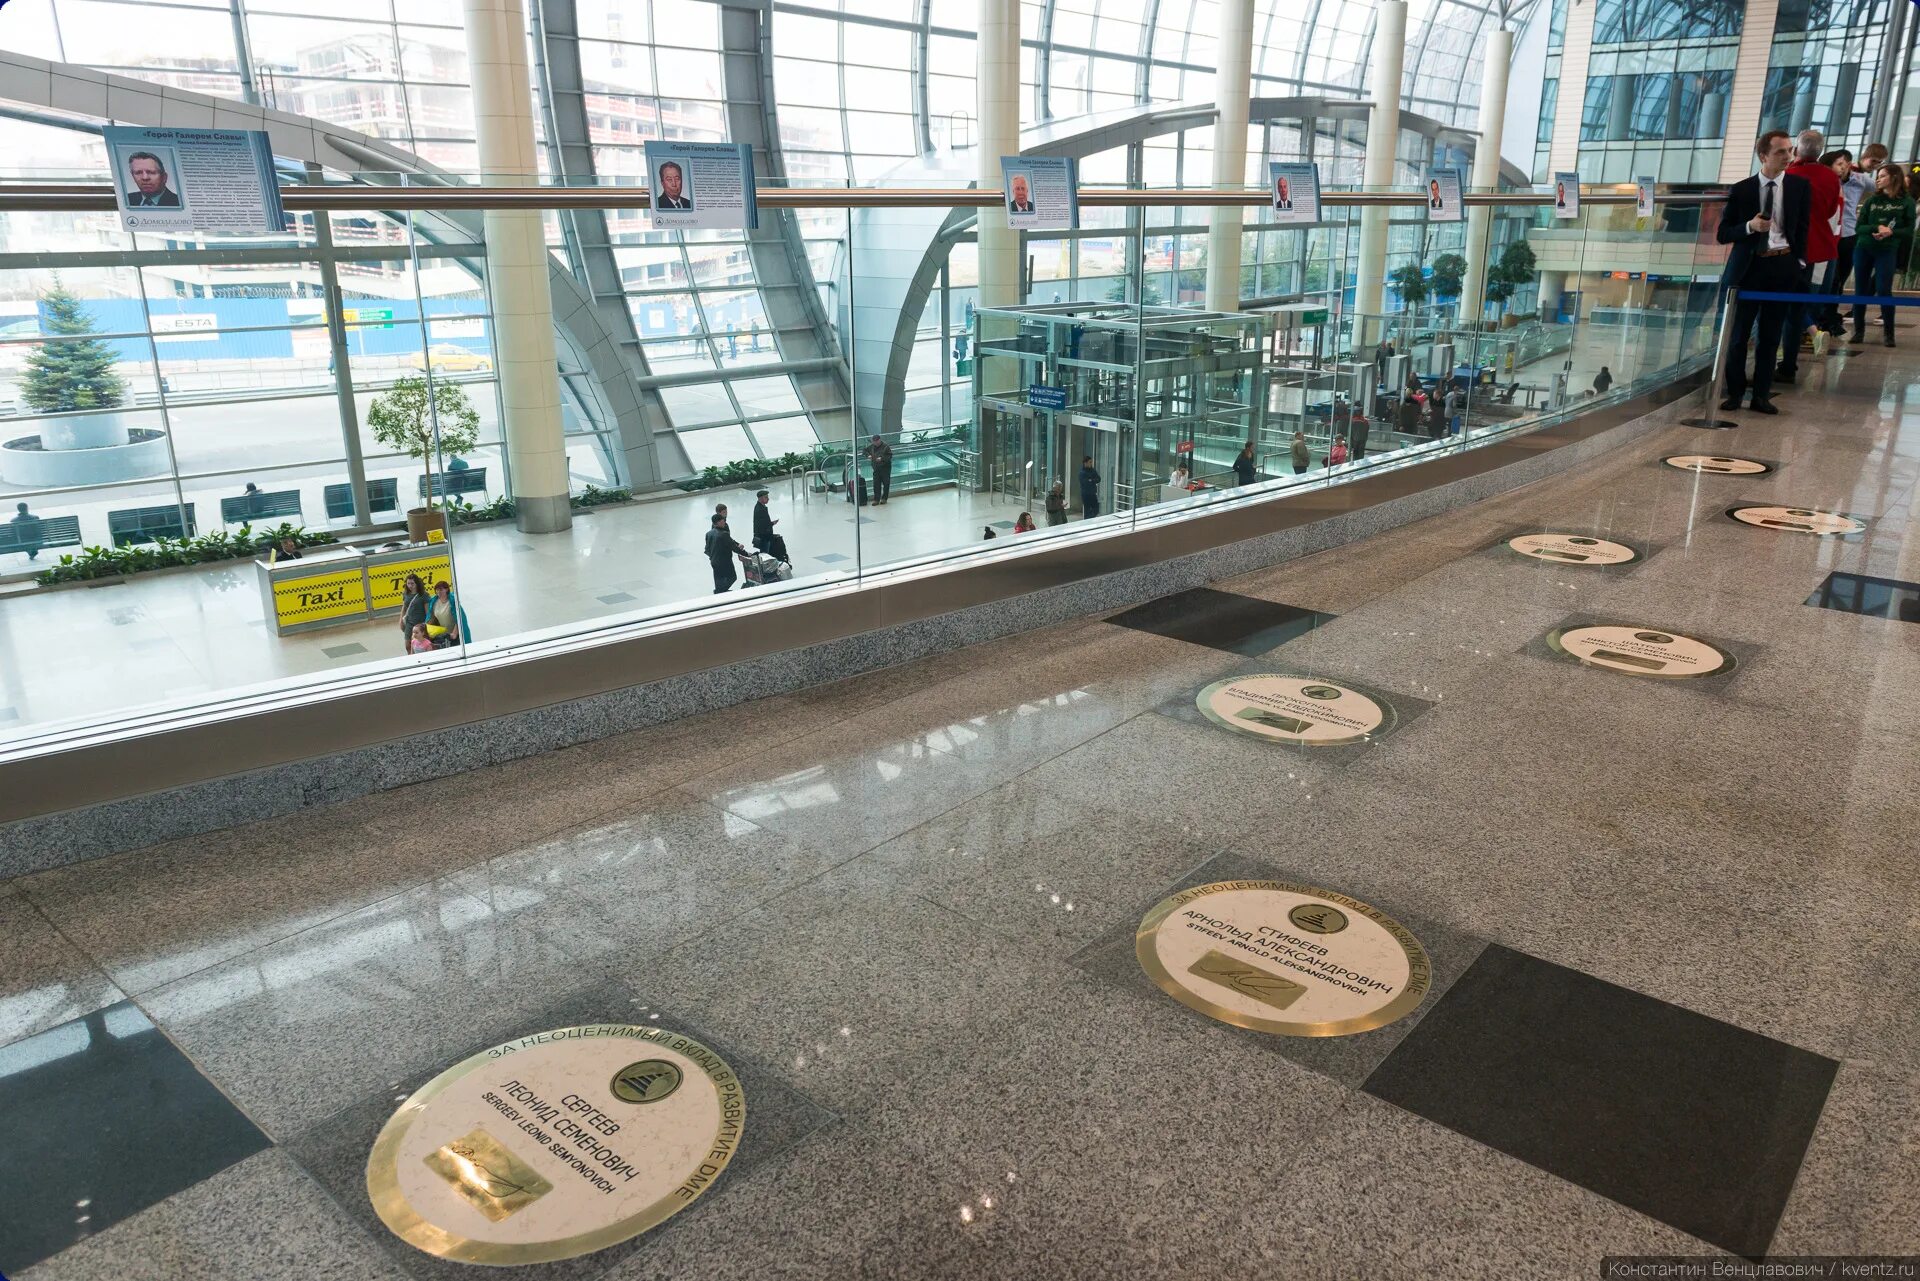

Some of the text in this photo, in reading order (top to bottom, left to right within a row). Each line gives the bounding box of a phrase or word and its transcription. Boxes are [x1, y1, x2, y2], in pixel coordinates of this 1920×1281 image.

[175, 318, 212, 327] ESTA
[297, 586, 345, 607] Taxi
[1172, 893, 1192, 903] ЗА
[1192, 882, 1312, 896] НЕОЦЕНИМЫЙ
[1317, 890, 1370, 912] ВКЛАД
[1369, 912, 1382, 920] В
[1182, 910, 1254, 941] АРНОЛЬД
[1255, 937, 1394, 994] АЛЕКСАНДРОВИЧ
[1186, 922, 1228, 940] STIFEEV
[1227, 940, 1270, 958] ARNOLD
[1270, 955, 1368, 996] ALEKSANDROVICH
[1259, 926, 1329, 956] СТИФЕЕВ
[488, 1027, 741, 1200] ЗА НЕОЦЕНИМЫЙ ВКЛАД В РАЗВИТИЕ DME
[500, 1080, 560, 1124] ЛЕОНИД
[553, 1118, 640, 1182] СЕМЕНОВИЧ
[561, 1094, 621, 1137] СЕРГЕЕВ
[481, 1092, 524, 1121] SERGEEV
[517, 1119, 553, 1145] LEONID
[548, 1143, 617, 1195] SEMYONOVICH
